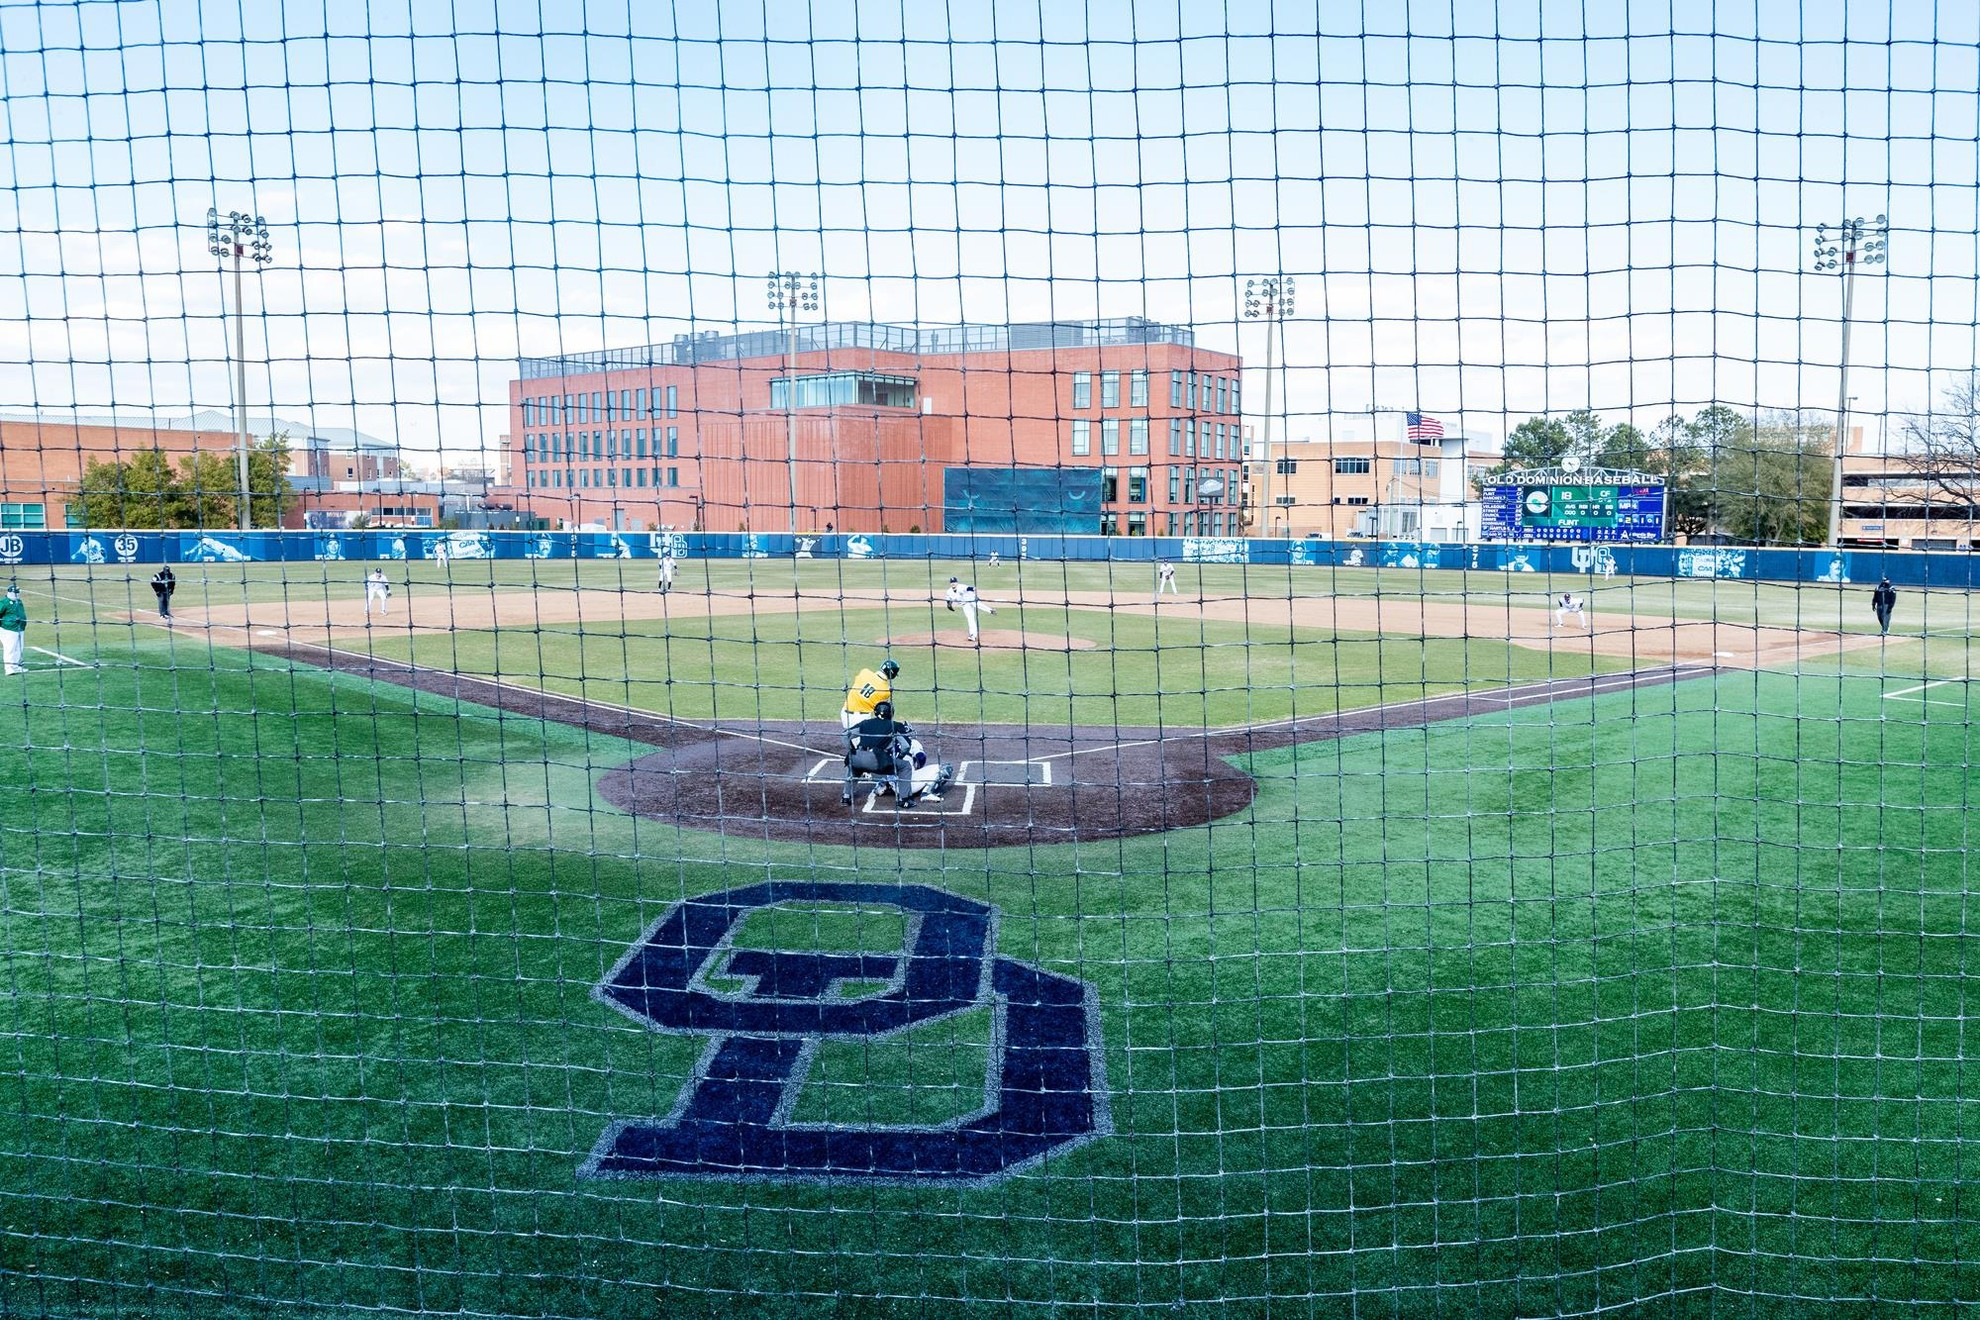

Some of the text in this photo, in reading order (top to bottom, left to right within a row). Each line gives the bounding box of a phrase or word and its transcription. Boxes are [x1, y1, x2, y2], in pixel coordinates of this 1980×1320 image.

[1487, 476, 1659, 485] OLD DOMINION BASEBALL
[1, 538, 21, 553] JB
[118, 538, 135, 551] 35
